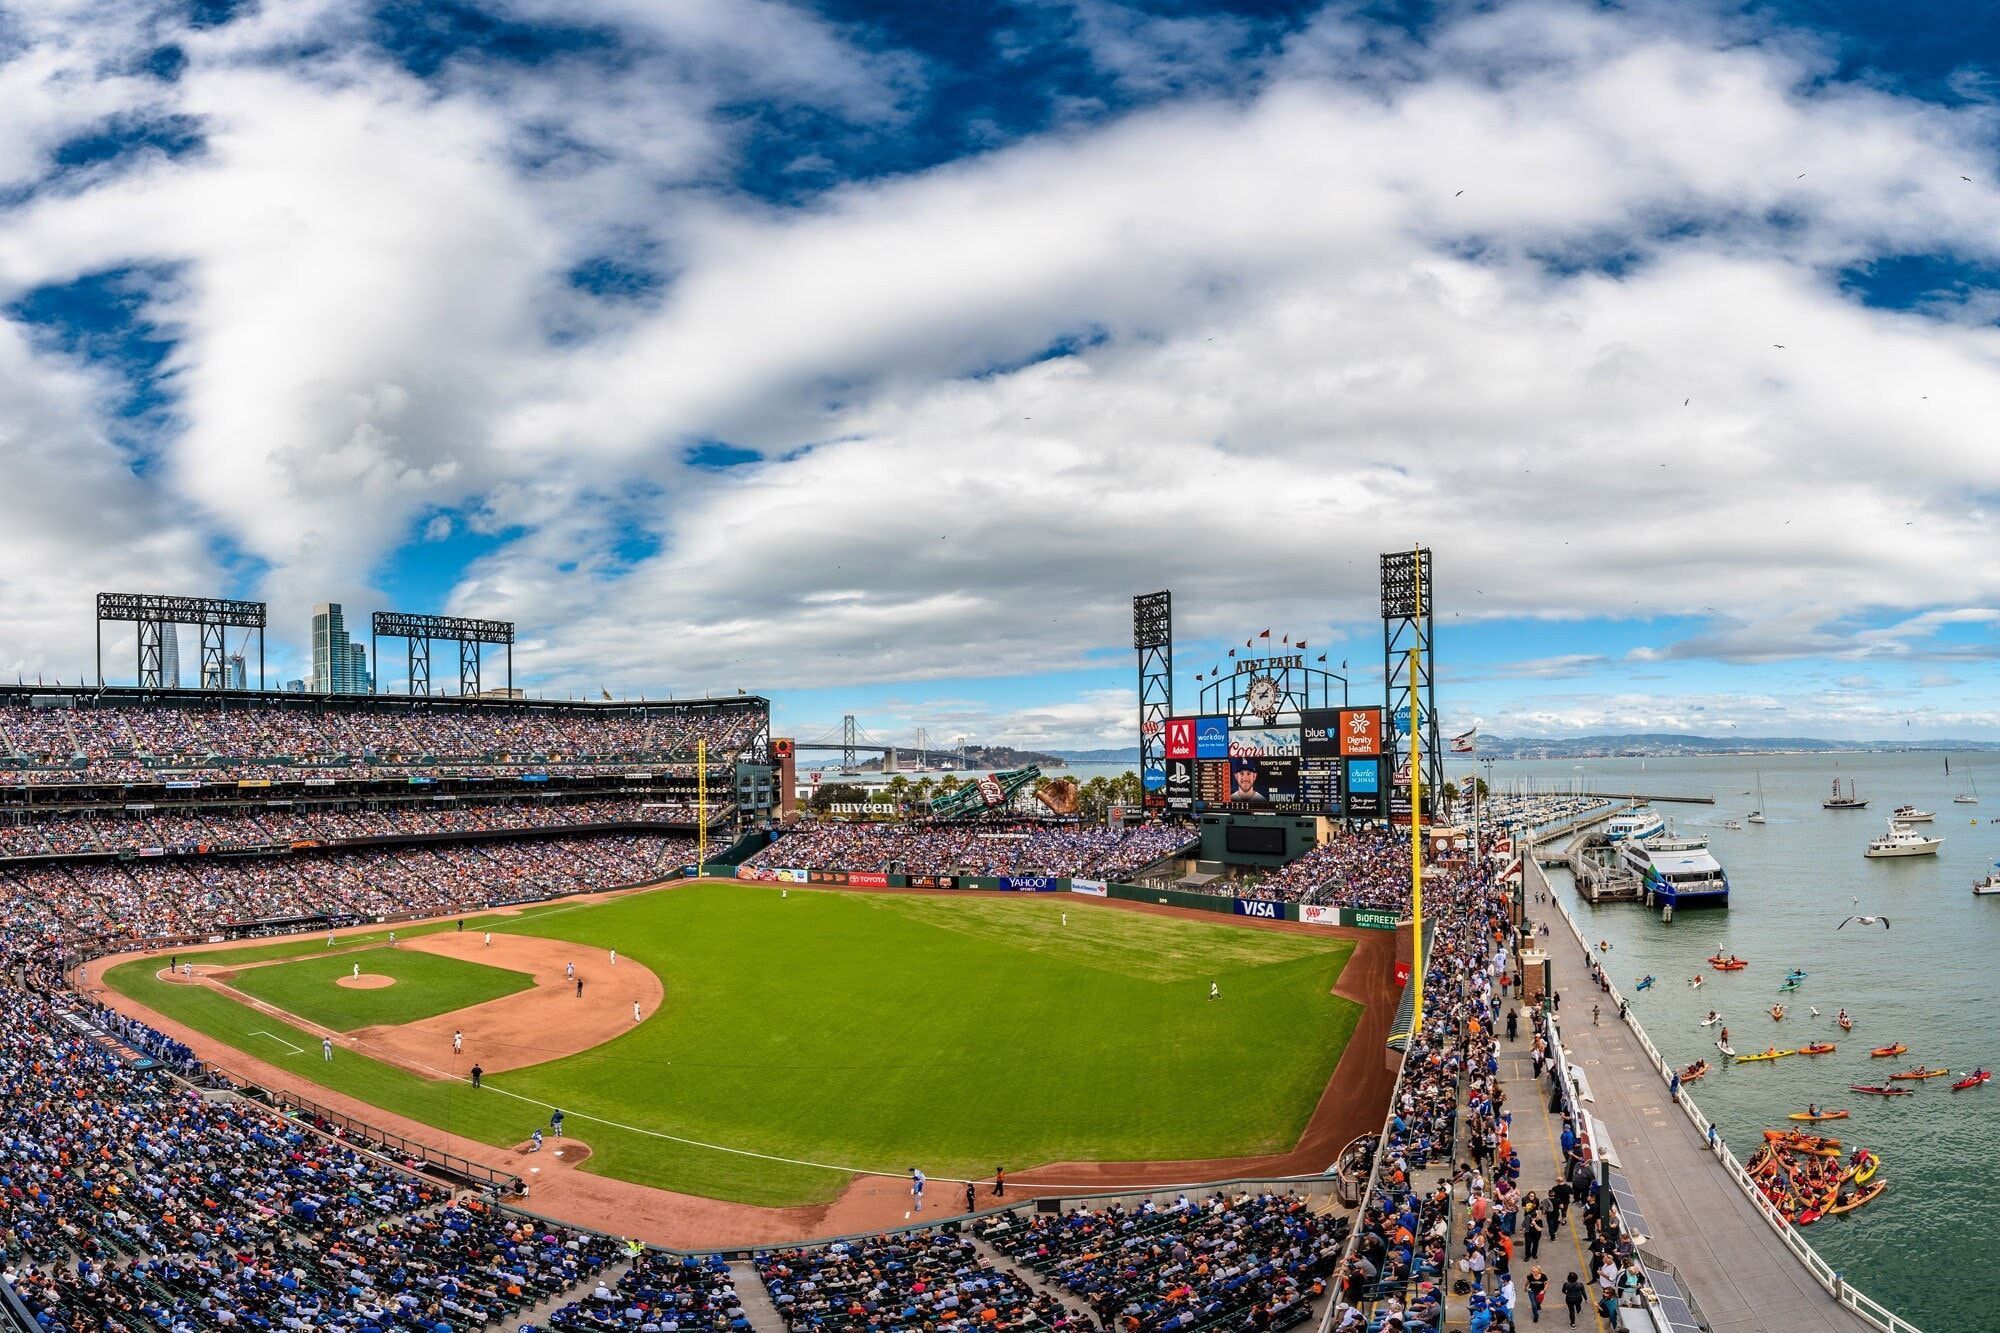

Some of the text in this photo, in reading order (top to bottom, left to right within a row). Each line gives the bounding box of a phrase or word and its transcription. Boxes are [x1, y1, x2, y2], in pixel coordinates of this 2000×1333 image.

[1236, 655, 1303, 673] AT&T PARK
[1305, 728, 1325, 738] blue
[1347, 736, 1372, 745] Dignity
[1230, 742, 1300, 757] Coors LIGHT
[1348, 744, 1371, 752] Health
[1352, 769, 1374, 777] charles
[1269, 793, 1295, 802] MUNCY
[830, 802, 894, 814] nuveen
[1009, 877, 1047, 888] YAHOO!
[1241, 900, 1275, 917] VISA
